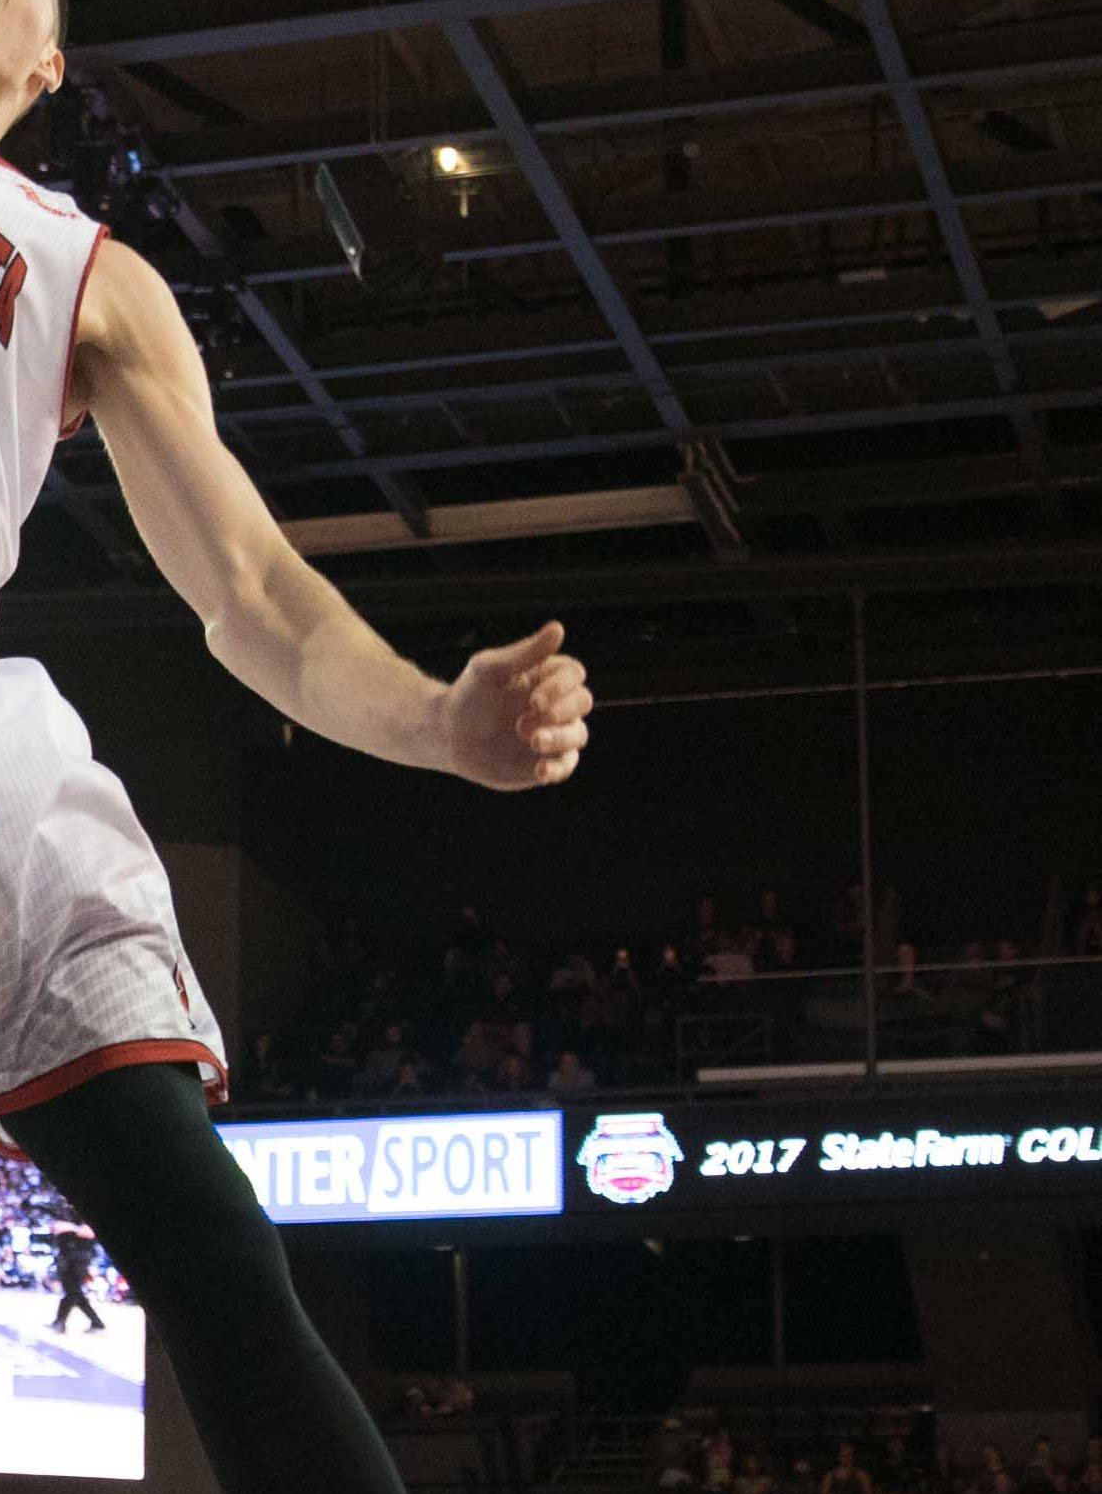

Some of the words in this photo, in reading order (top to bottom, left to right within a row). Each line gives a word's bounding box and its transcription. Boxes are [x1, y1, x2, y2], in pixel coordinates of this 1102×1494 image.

[223, 1134, 367, 1207] NTER
[382, 1129, 543, 1199] SPORT
[699, 1138, 807, 1176] 2017
[1017, 1126, 1102, 1163] COL
